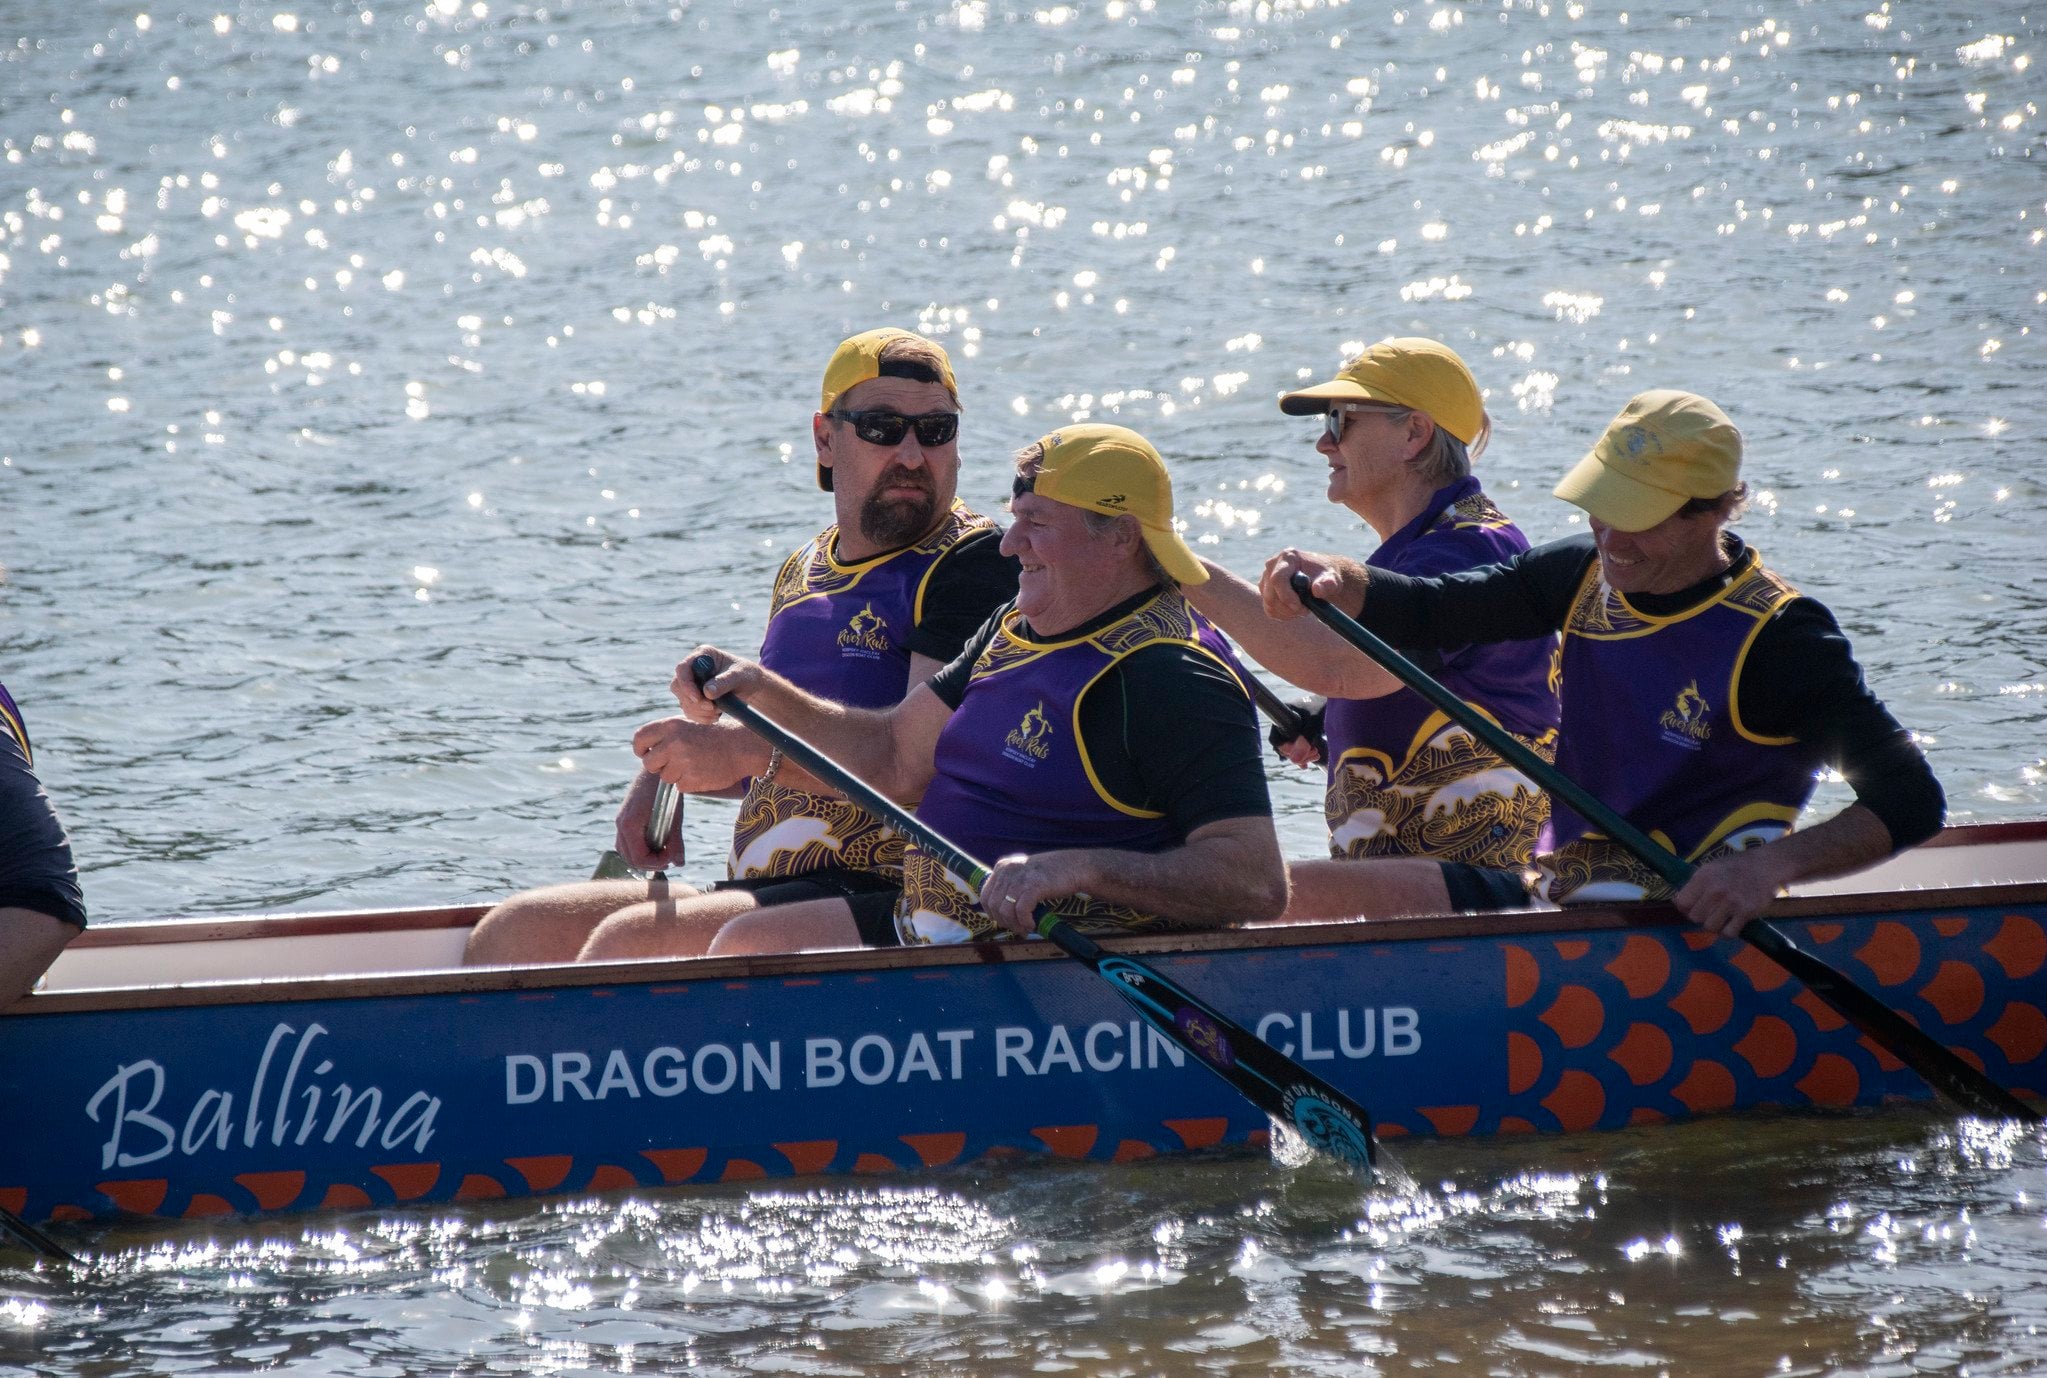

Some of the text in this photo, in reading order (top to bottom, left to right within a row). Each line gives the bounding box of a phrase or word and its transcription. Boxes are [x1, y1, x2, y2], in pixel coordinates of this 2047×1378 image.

[863, 631, 888, 650] Rats
[1660, 710, 1711, 739] River Rats
[1025, 735, 1049, 758] Rats
[505, 1041, 781, 1105] DRAGON
[805, 1030, 974, 1088] BOAT
[995, 1020, 1185, 1077] RACIN
[1255, 1007, 1422, 1061] CLUB
[86, 1023, 441, 1169] Ballina
[1283, 1084, 1361, 1128] YPSY DRAGONS
